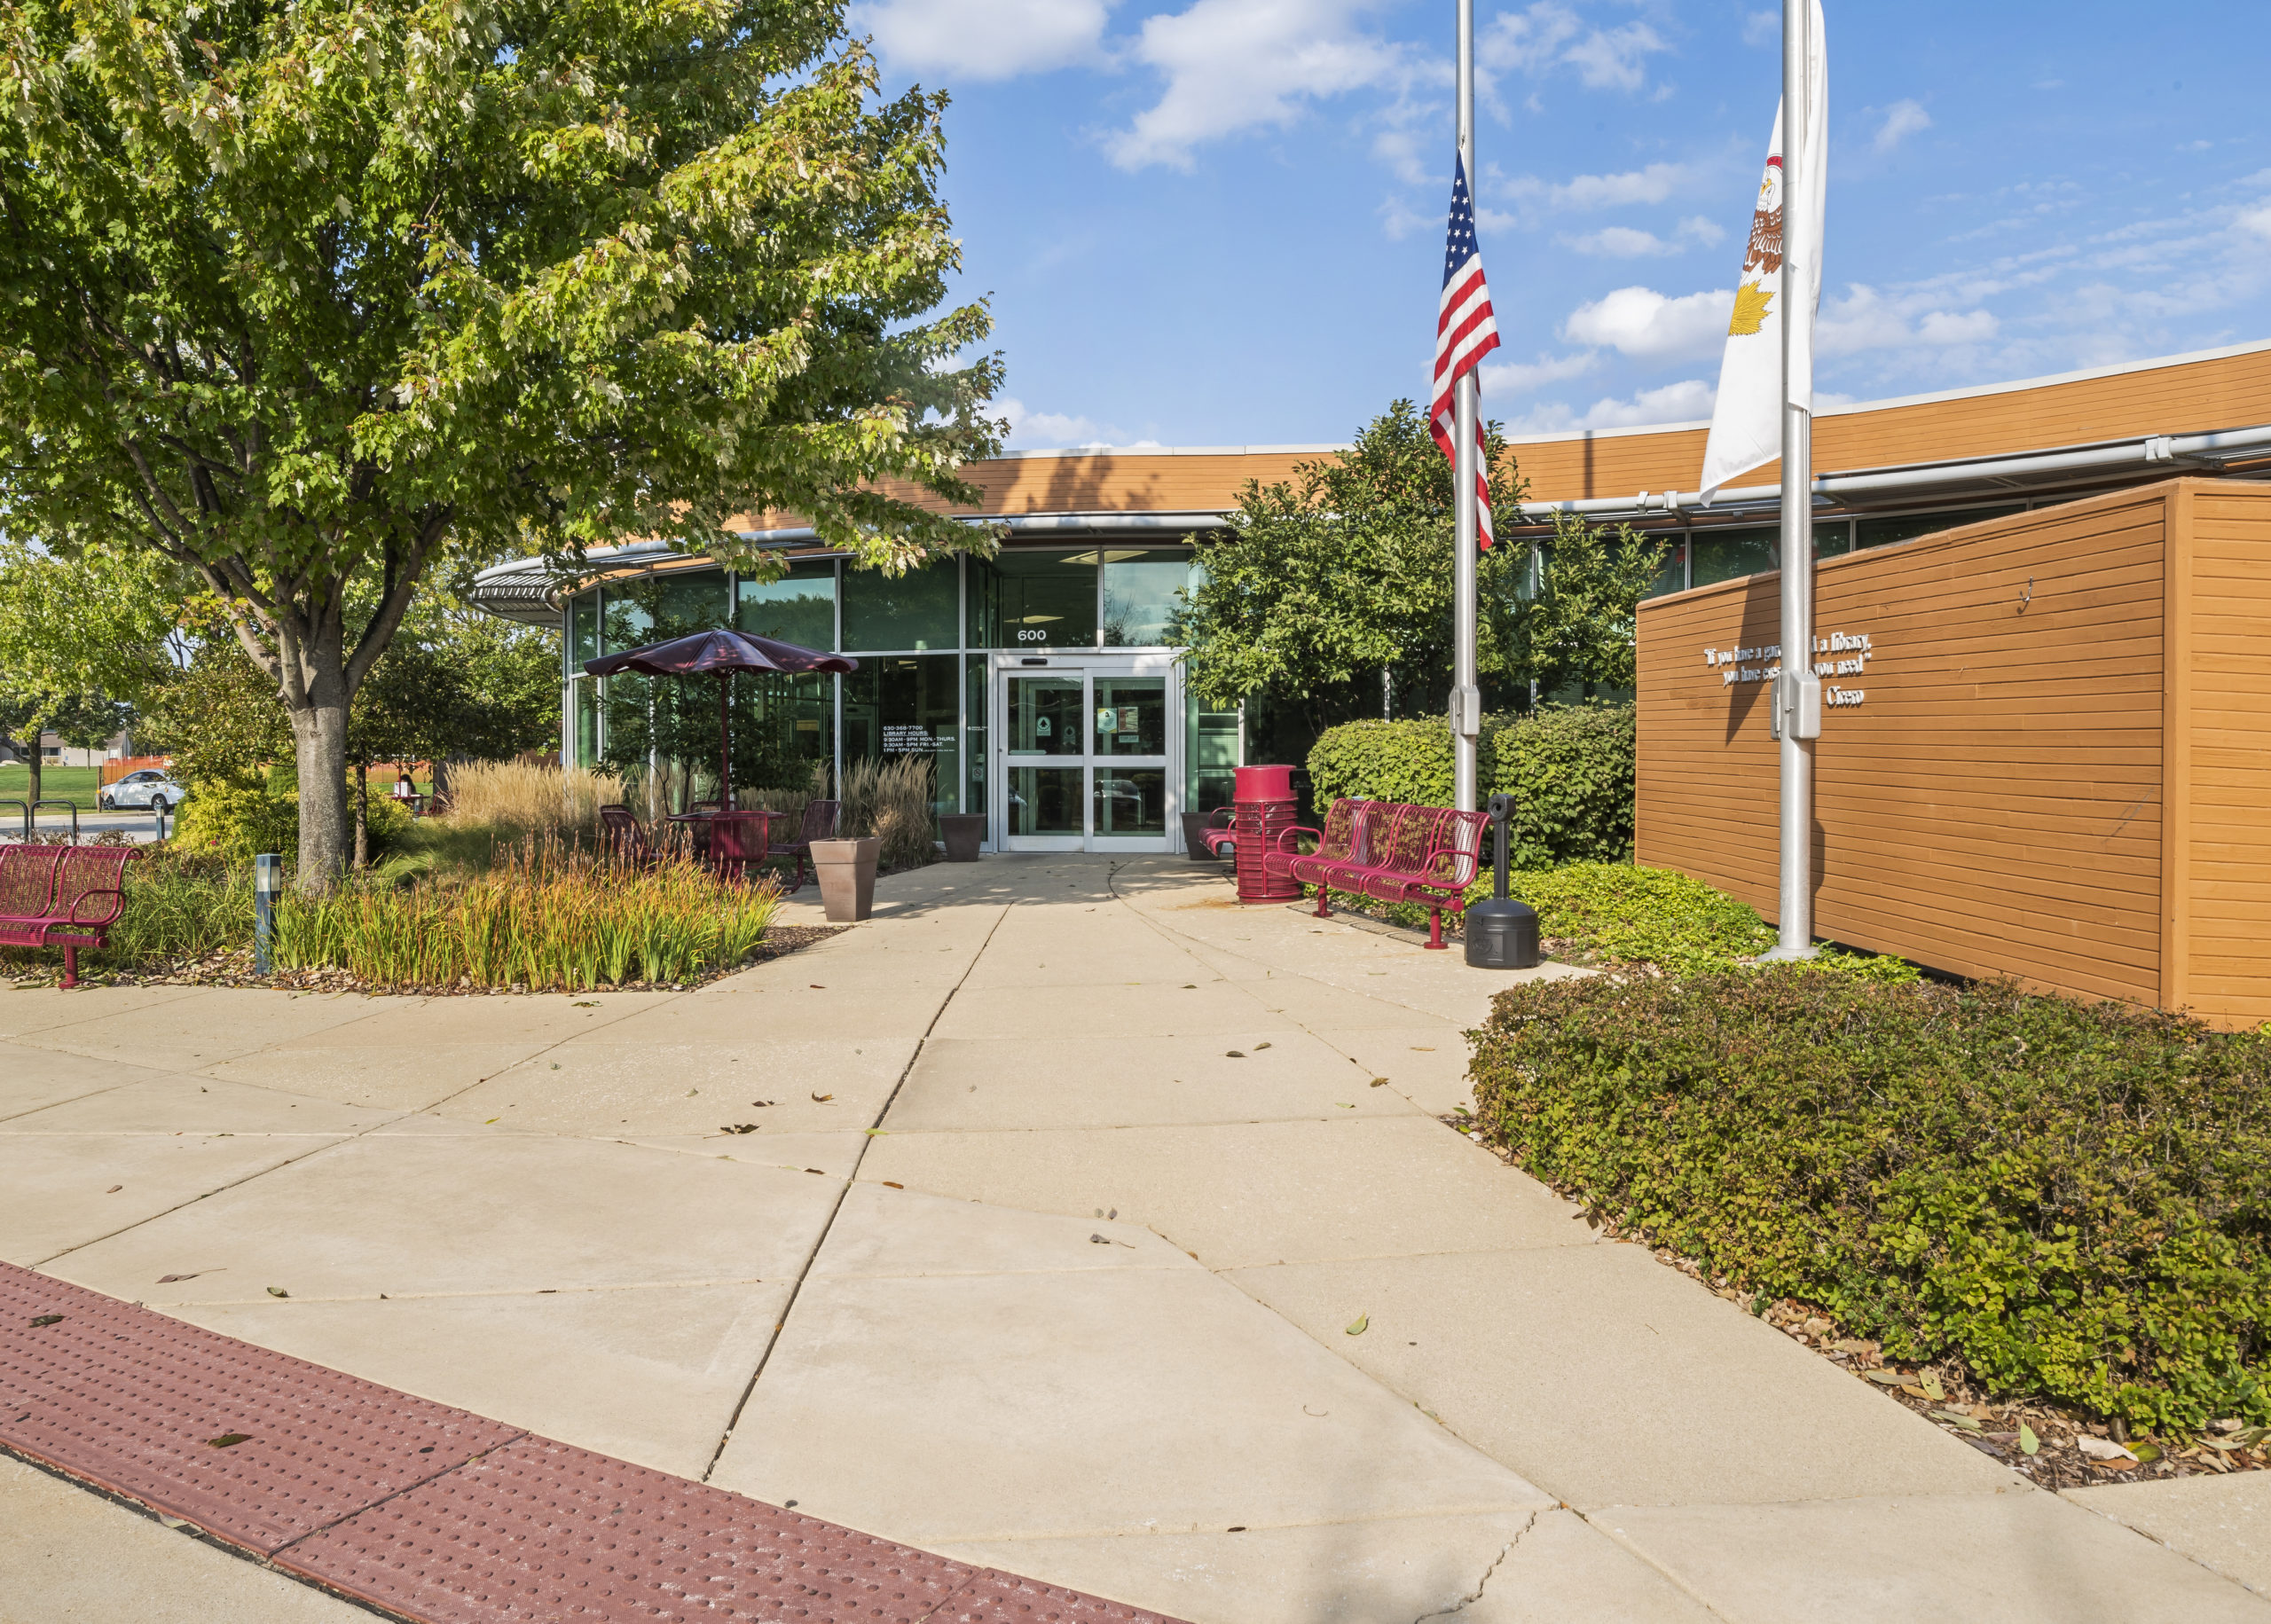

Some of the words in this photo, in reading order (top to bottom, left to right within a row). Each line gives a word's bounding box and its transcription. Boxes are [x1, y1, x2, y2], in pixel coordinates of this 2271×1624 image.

[1018, 630, 1047, 641] 600
[1717, 651, 1733, 667] you
[1733, 645, 1754, 662] have
[1755, 647, 1762, 659] a
[1819, 639, 1828, 652] a
[1830, 632, 1872, 652] library,
[1723, 671, 1739, 686] you
[1741, 665, 1761, 681] have
[1812, 662, 1834, 679] you
[1827, 685, 1865, 705] Cicero
